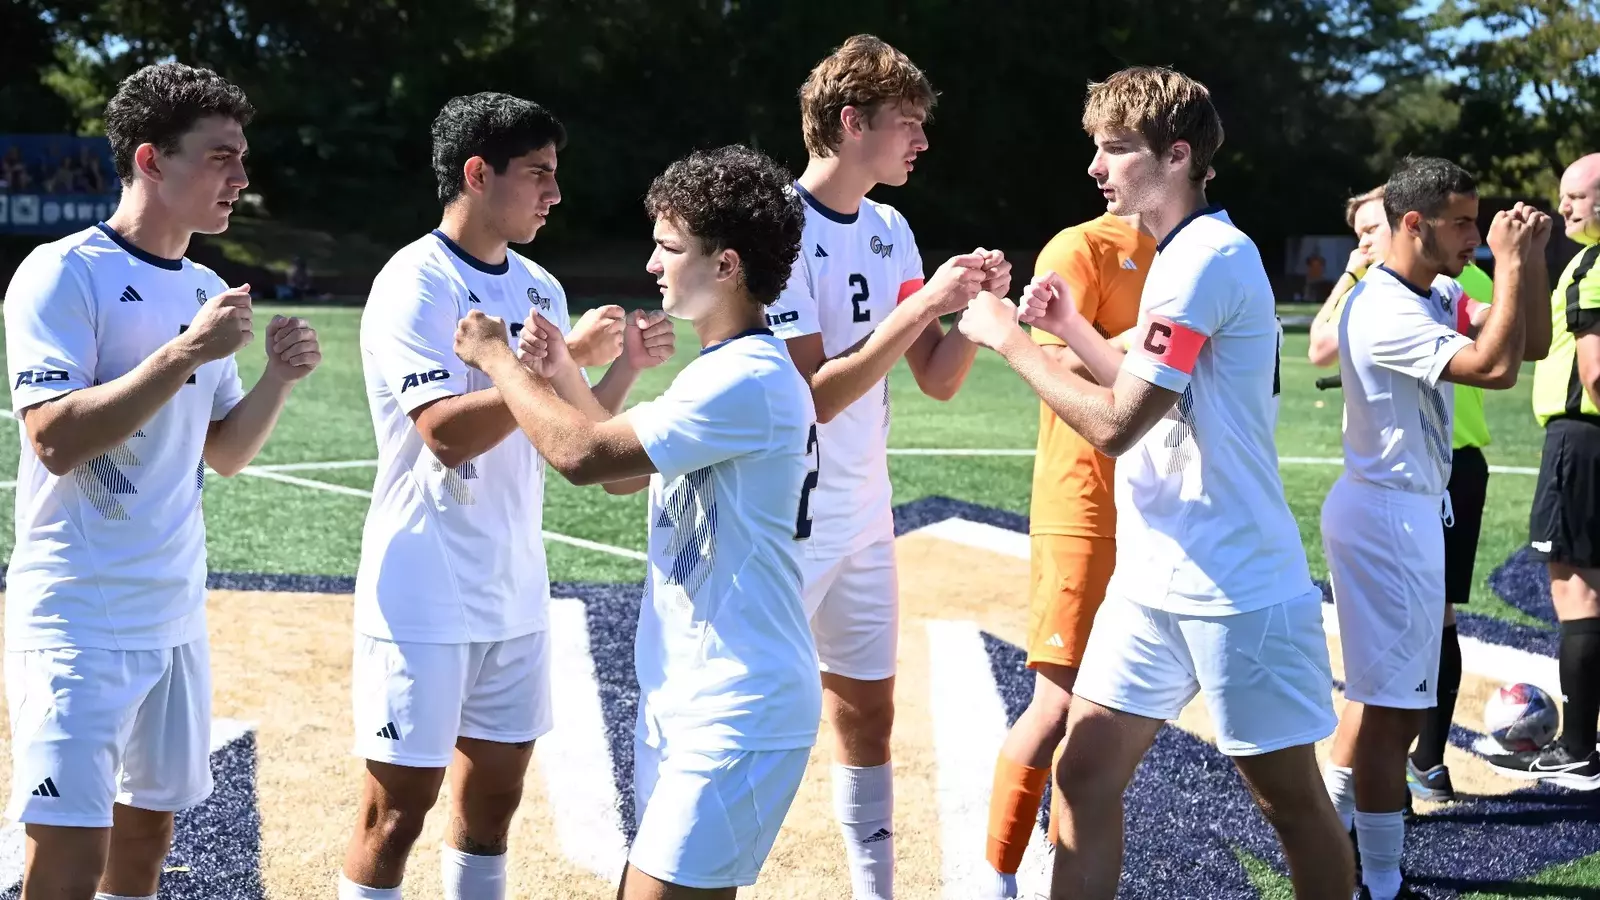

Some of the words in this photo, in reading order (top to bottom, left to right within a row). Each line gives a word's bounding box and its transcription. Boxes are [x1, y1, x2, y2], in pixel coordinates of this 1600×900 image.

[870, 235, 894, 259] GW
[848, 273, 871, 323] 2
[1143, 321, 1172, 355] C
[14, 370, 70, 391] A10
[401, 369, 450, 394] A10
